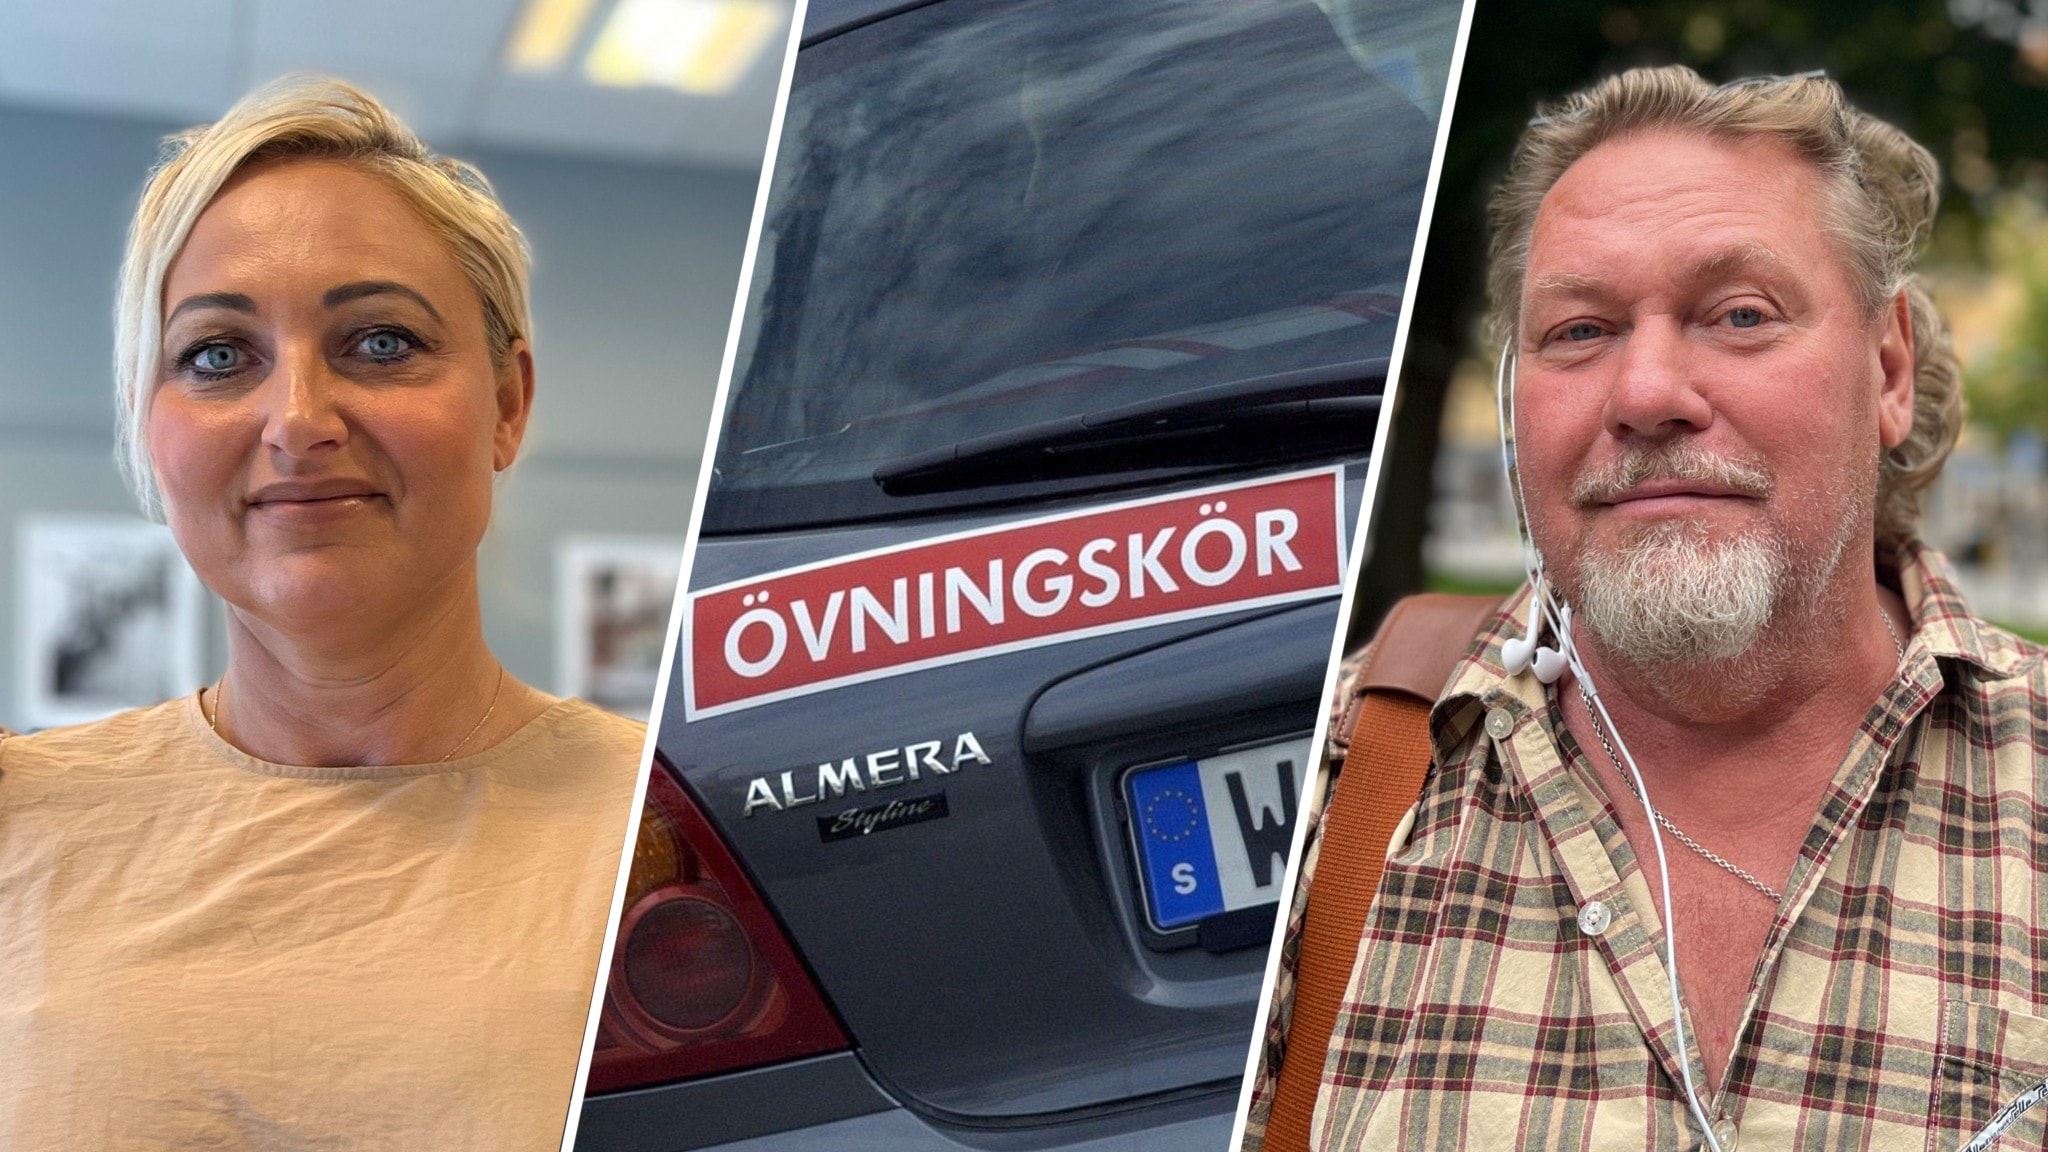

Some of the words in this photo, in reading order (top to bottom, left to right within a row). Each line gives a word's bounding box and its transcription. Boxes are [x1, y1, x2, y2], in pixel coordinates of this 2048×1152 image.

[724, 501, 1302, 678] ÖVNINGSKÖR
[743, 731, 992, 817] ALMERA
[830, 800, 930, 835] Styline
[1224, 760, 1298, 888] W
[1171, 863, 1197, 895] S
